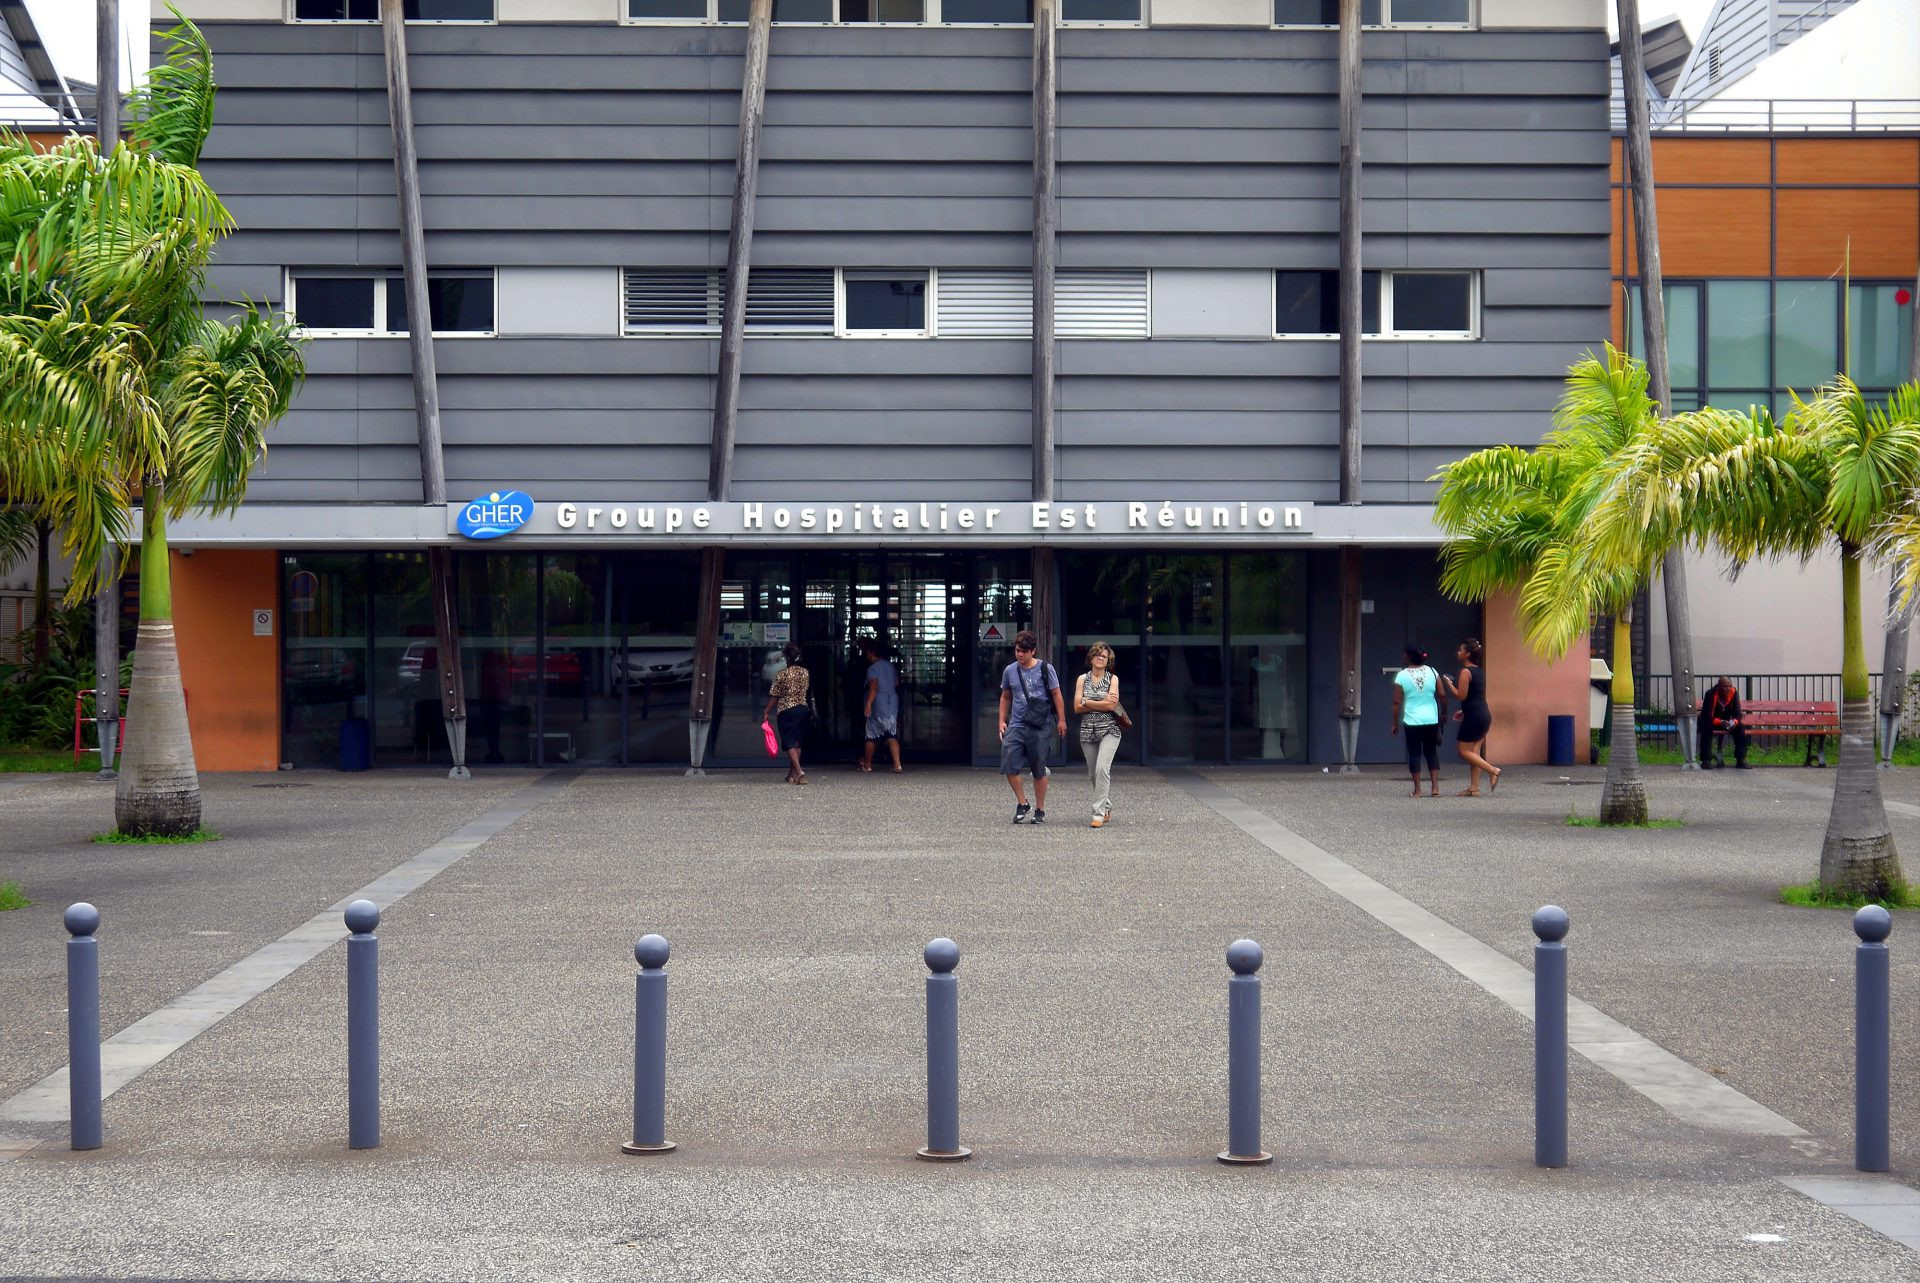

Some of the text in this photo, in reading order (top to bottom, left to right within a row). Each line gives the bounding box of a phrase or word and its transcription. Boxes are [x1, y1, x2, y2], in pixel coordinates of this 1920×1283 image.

[466, 504, 524, 523] GHER
[557, 500, 1302, 533] Groupe Hospitalier Est Réunion
